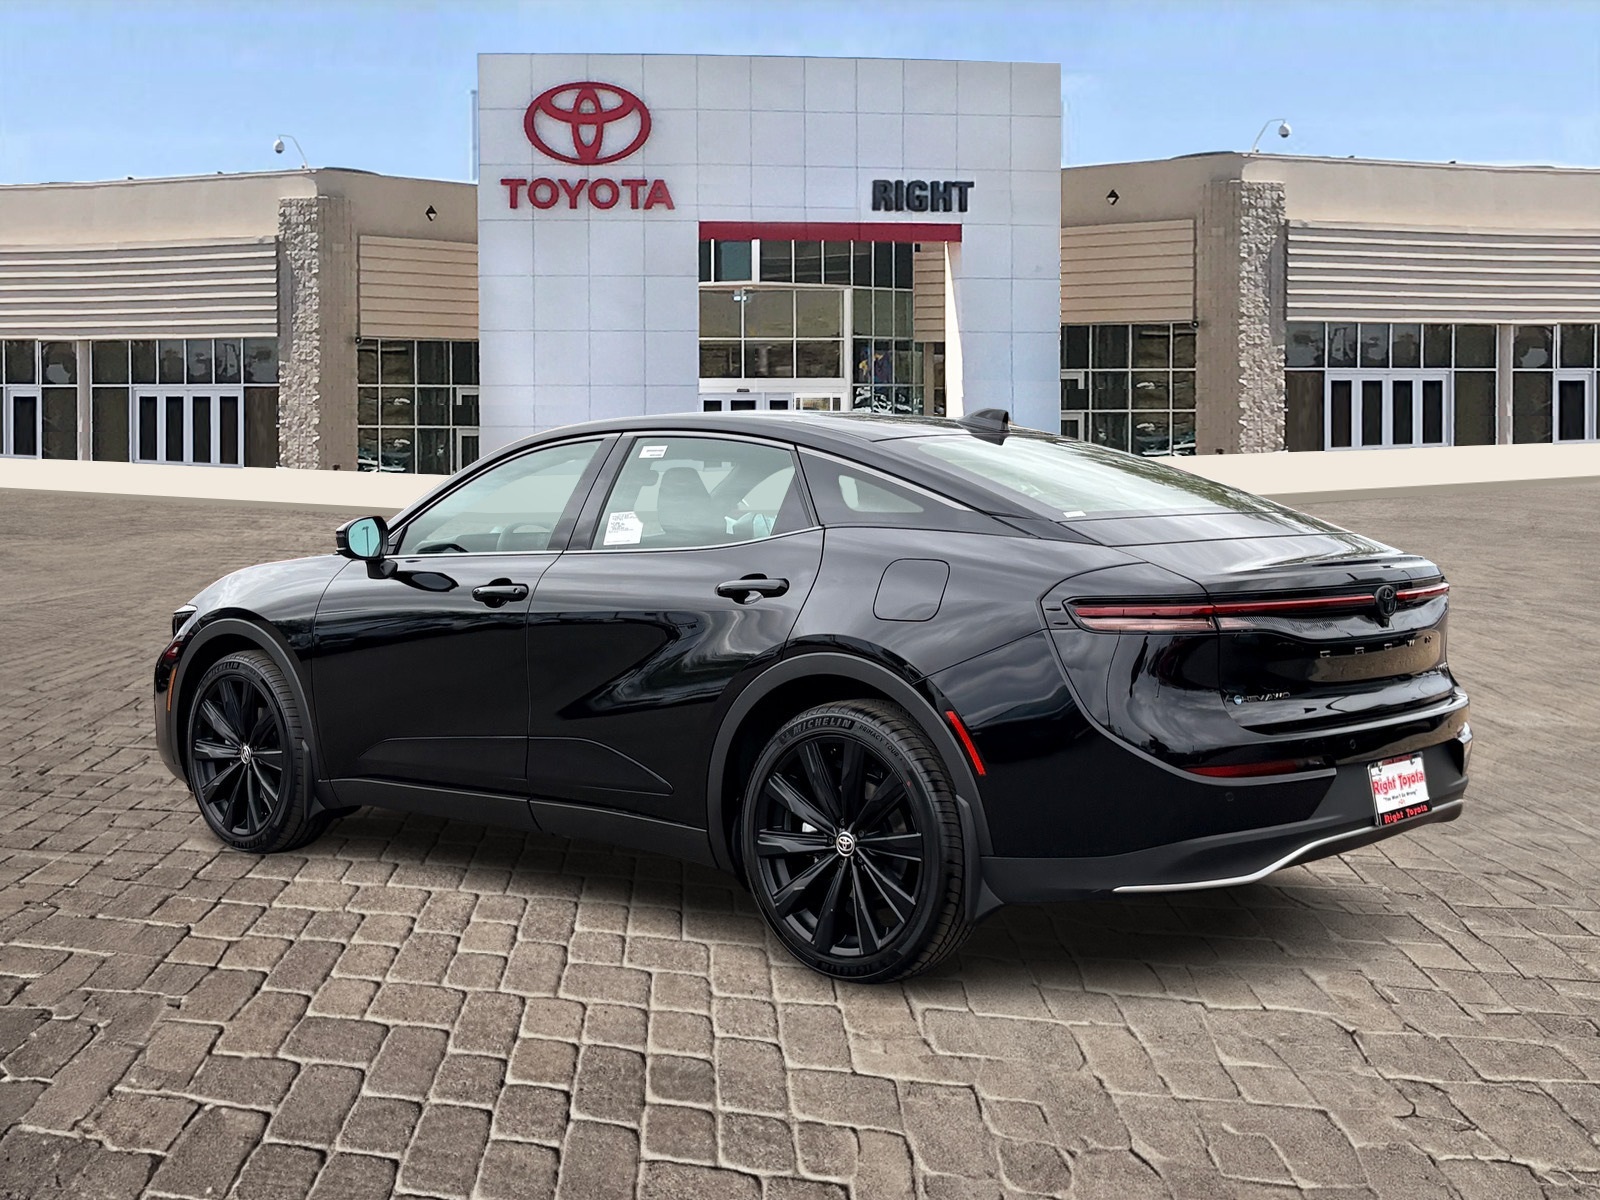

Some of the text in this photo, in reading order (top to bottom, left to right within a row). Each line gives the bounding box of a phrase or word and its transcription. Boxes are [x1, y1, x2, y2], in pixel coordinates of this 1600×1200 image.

[500, 178, 675, 210] TOYOTA
[871, 179, 976, 214] RIGHT
[792, 717, 852, 735] MICHELIN
[858, 725, 900, 758] PRIMACY TOUR
[1372, 770, 1424, 794] Right Toyota
[1384, 804, 1428, 824] Right Toyota
